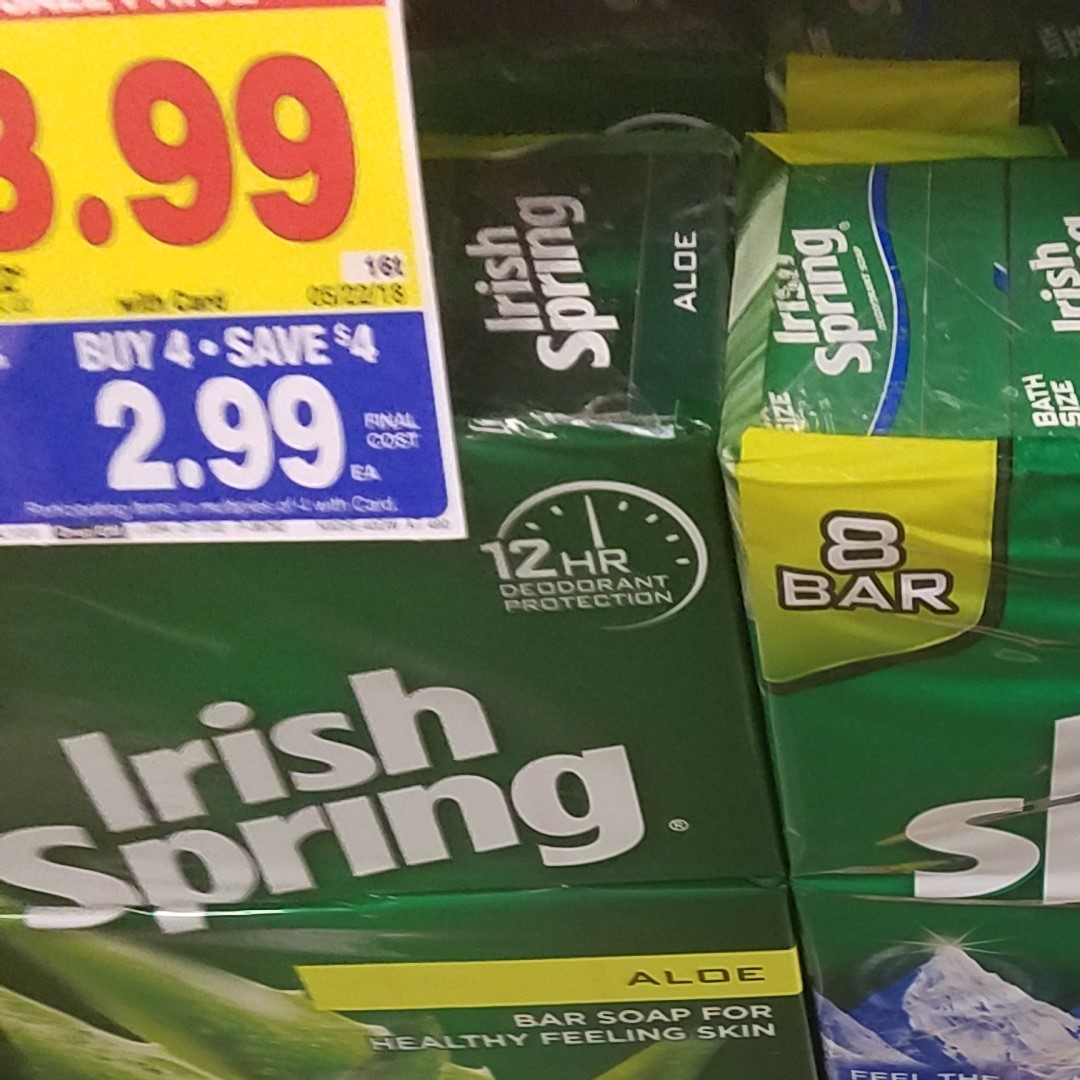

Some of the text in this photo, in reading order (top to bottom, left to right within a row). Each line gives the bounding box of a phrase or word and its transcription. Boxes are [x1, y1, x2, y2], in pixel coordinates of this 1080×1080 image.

[465, 225, 544, 331] Irish
[515, 195, 620, 371] Spring
[673, 230, 698, 313] ALOE
[791, 227, 878, 377] Spring
[73, 330, 155, 371] BUY
[163, 329, 195, 369] 4
[224, 325, 333, 368] SAVE
[1021, 374, 1061, 428] BATH
[95, 374, 347, 490] 2.99
[365, 431, 421, 450] COST
[350, 463, 381, 482] EA
[480, 538, 631, 580] 12 HR
[823, 513, 903, 573] 8
[500, 574, 669, 599] DEODORANT
[504, 591, 673, 613] PROTECTION
[779, 568, 957, 612] BAR
[58, 667, 498, 833] Irish
[0, 744, 646, 935] Spring
[627, 966, 767, 987] ALOE
[369, 1021, 777, 1053] HEALTHY FEELING SKIN
[513, 1003, 773, 1029] BAR SOAP FOR
